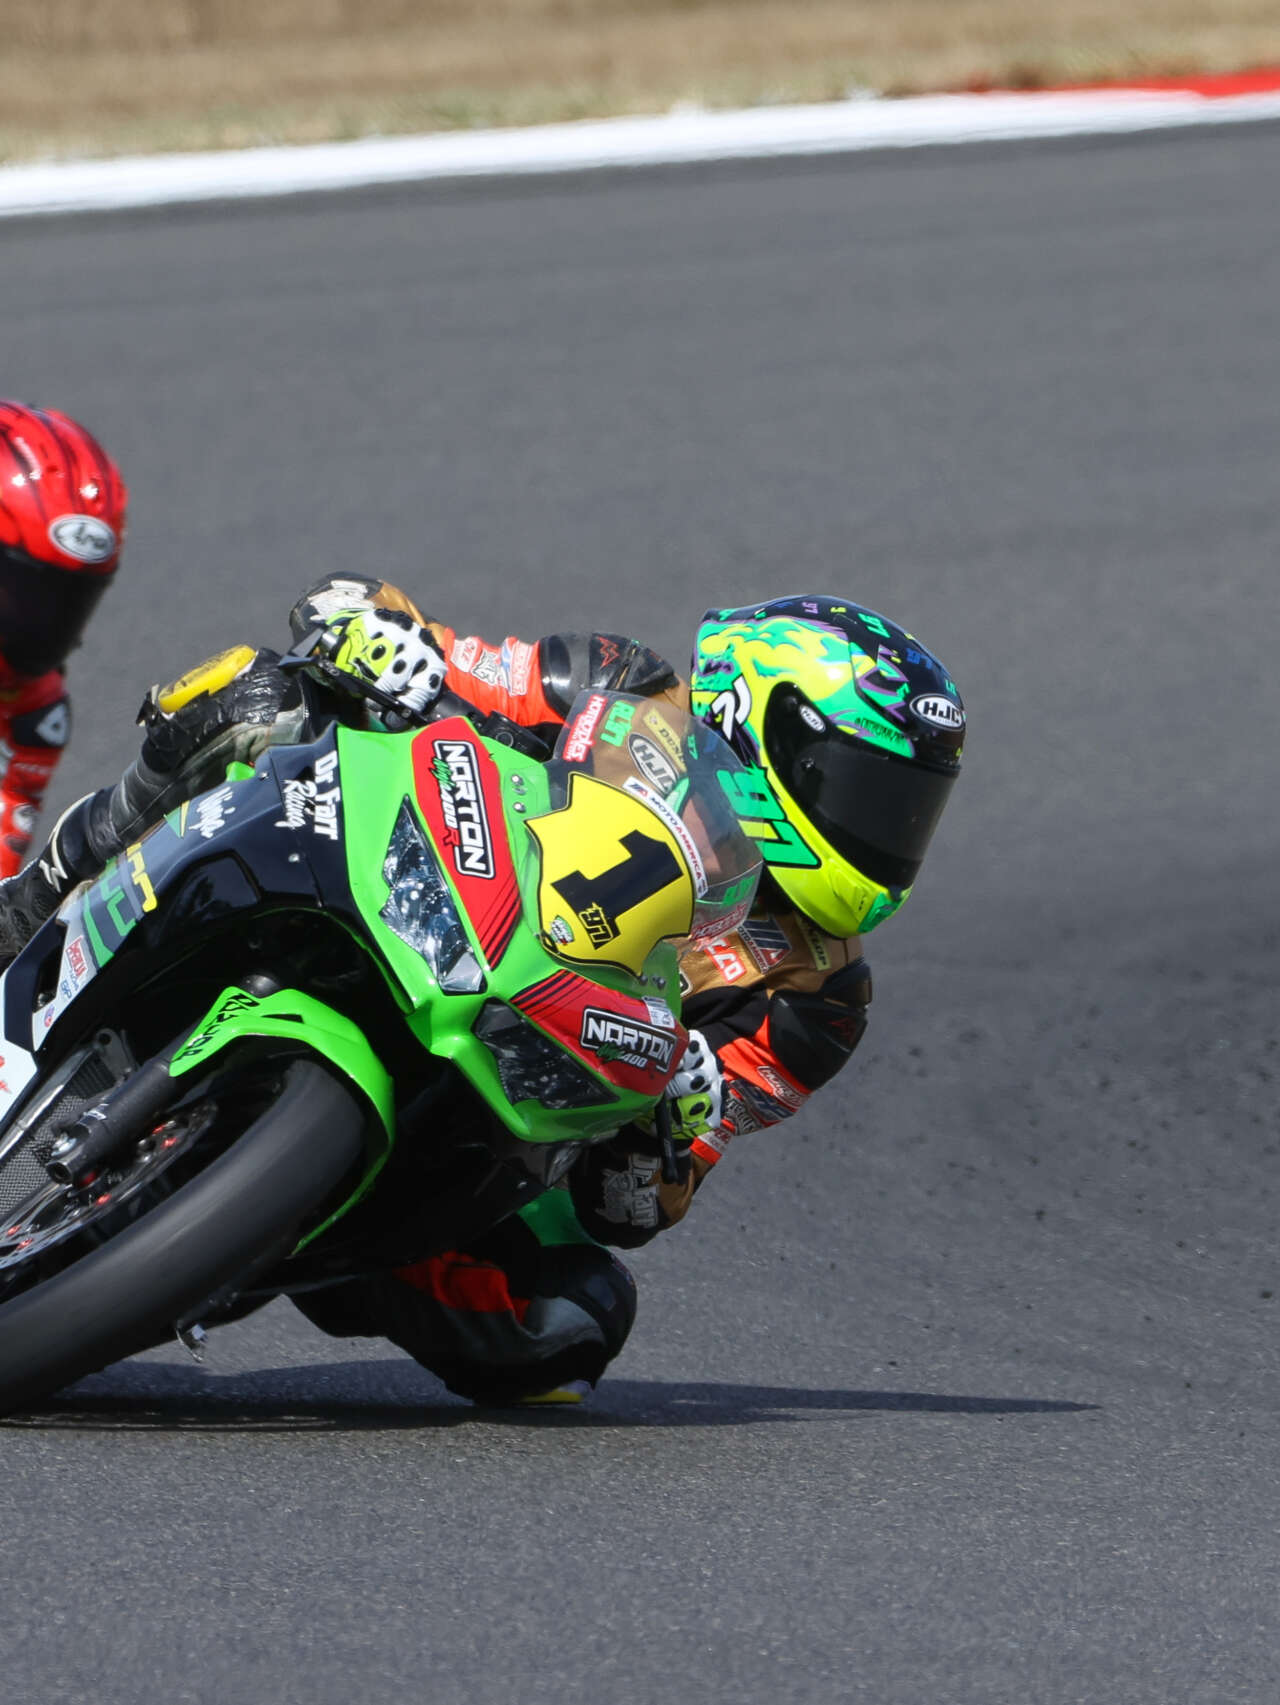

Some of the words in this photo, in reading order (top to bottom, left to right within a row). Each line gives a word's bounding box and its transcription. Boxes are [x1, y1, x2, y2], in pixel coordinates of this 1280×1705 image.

[921, 702, 962, 725] HJC
[315, 750, 338, 784] Dr
[275, 779, 317, 830] Racing
[314, 786, 342, 841] Farr
[443, 743, 487, 873] NORTON
[648, 794, 704, 880] MOTOAMERICA
[551, 829, 683, 950] 1
[587, 1017, 674, 1064] NORTON
